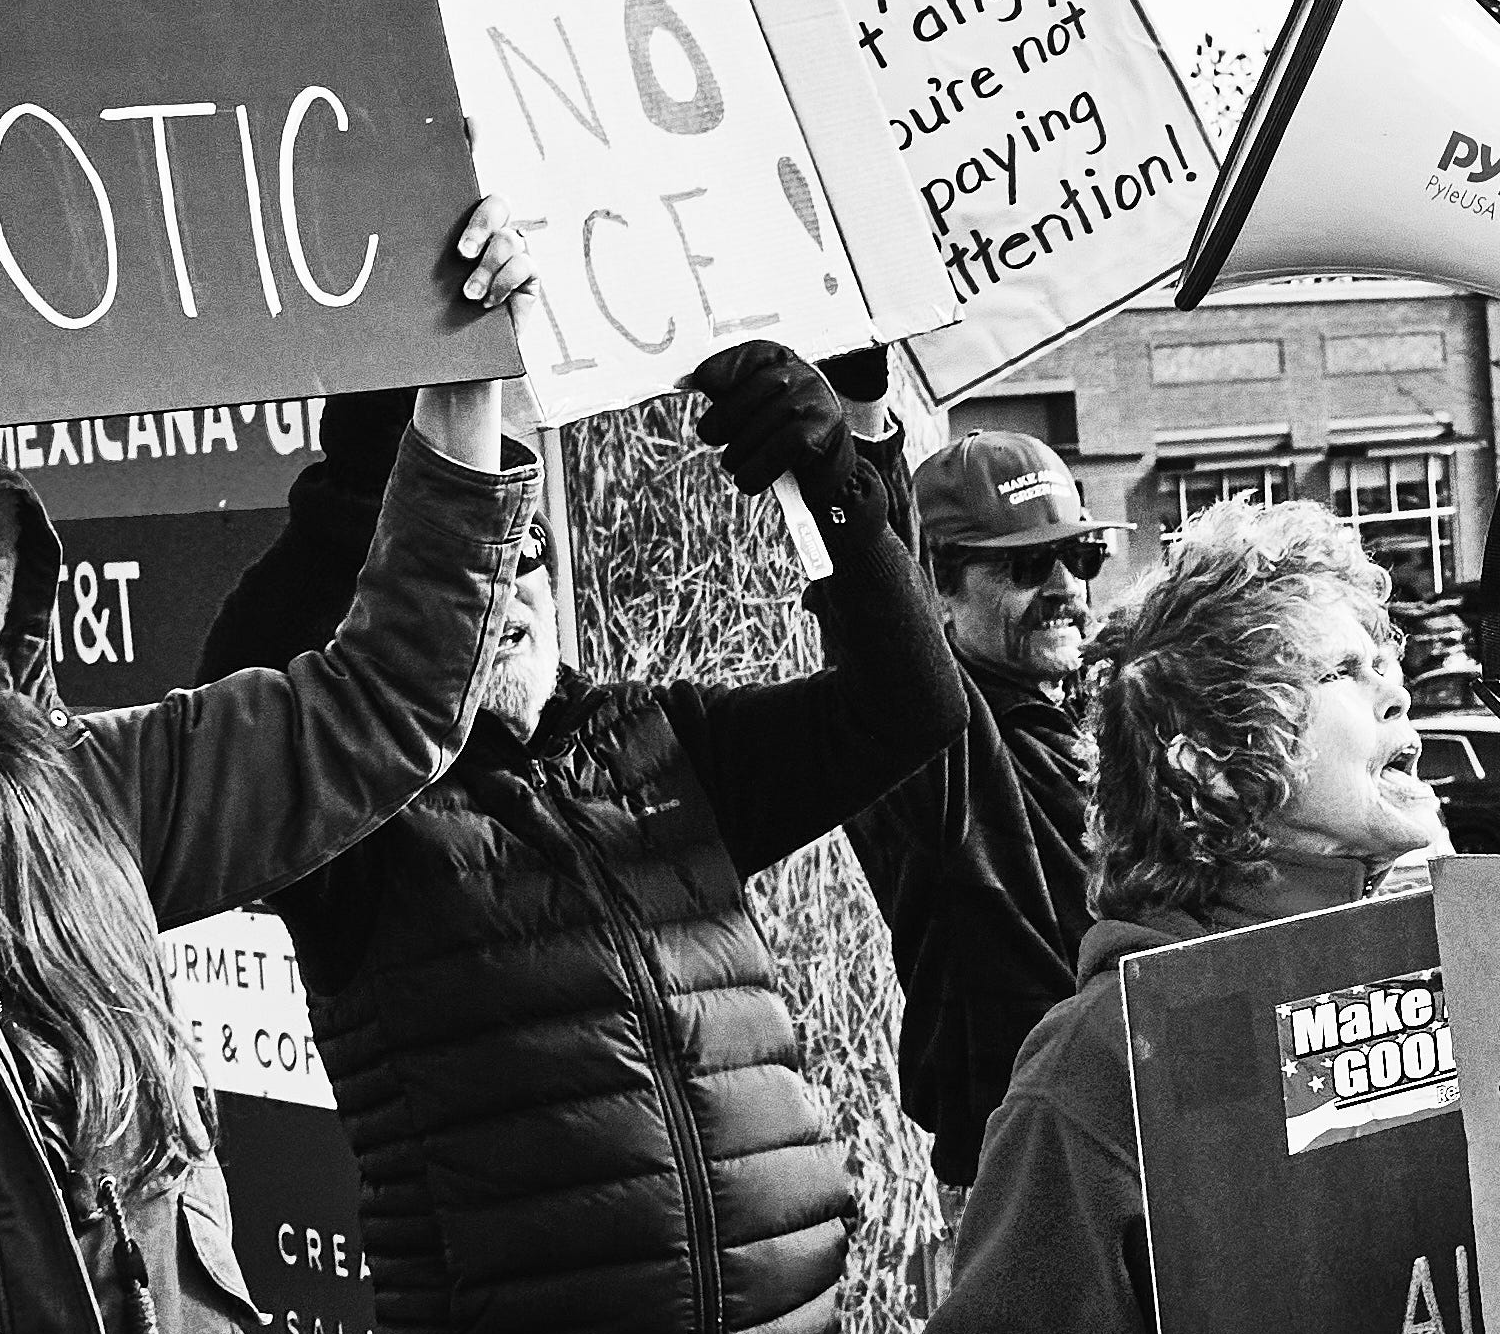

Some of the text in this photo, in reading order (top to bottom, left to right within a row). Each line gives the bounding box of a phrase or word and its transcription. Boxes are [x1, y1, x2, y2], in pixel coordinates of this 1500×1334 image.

[888, 0, 1087, 151] ou're not
[919, 91, 1107, 237] paying
[221, 1023, 239, 1064] &
[1290, 987, 1435, 1057] Make
